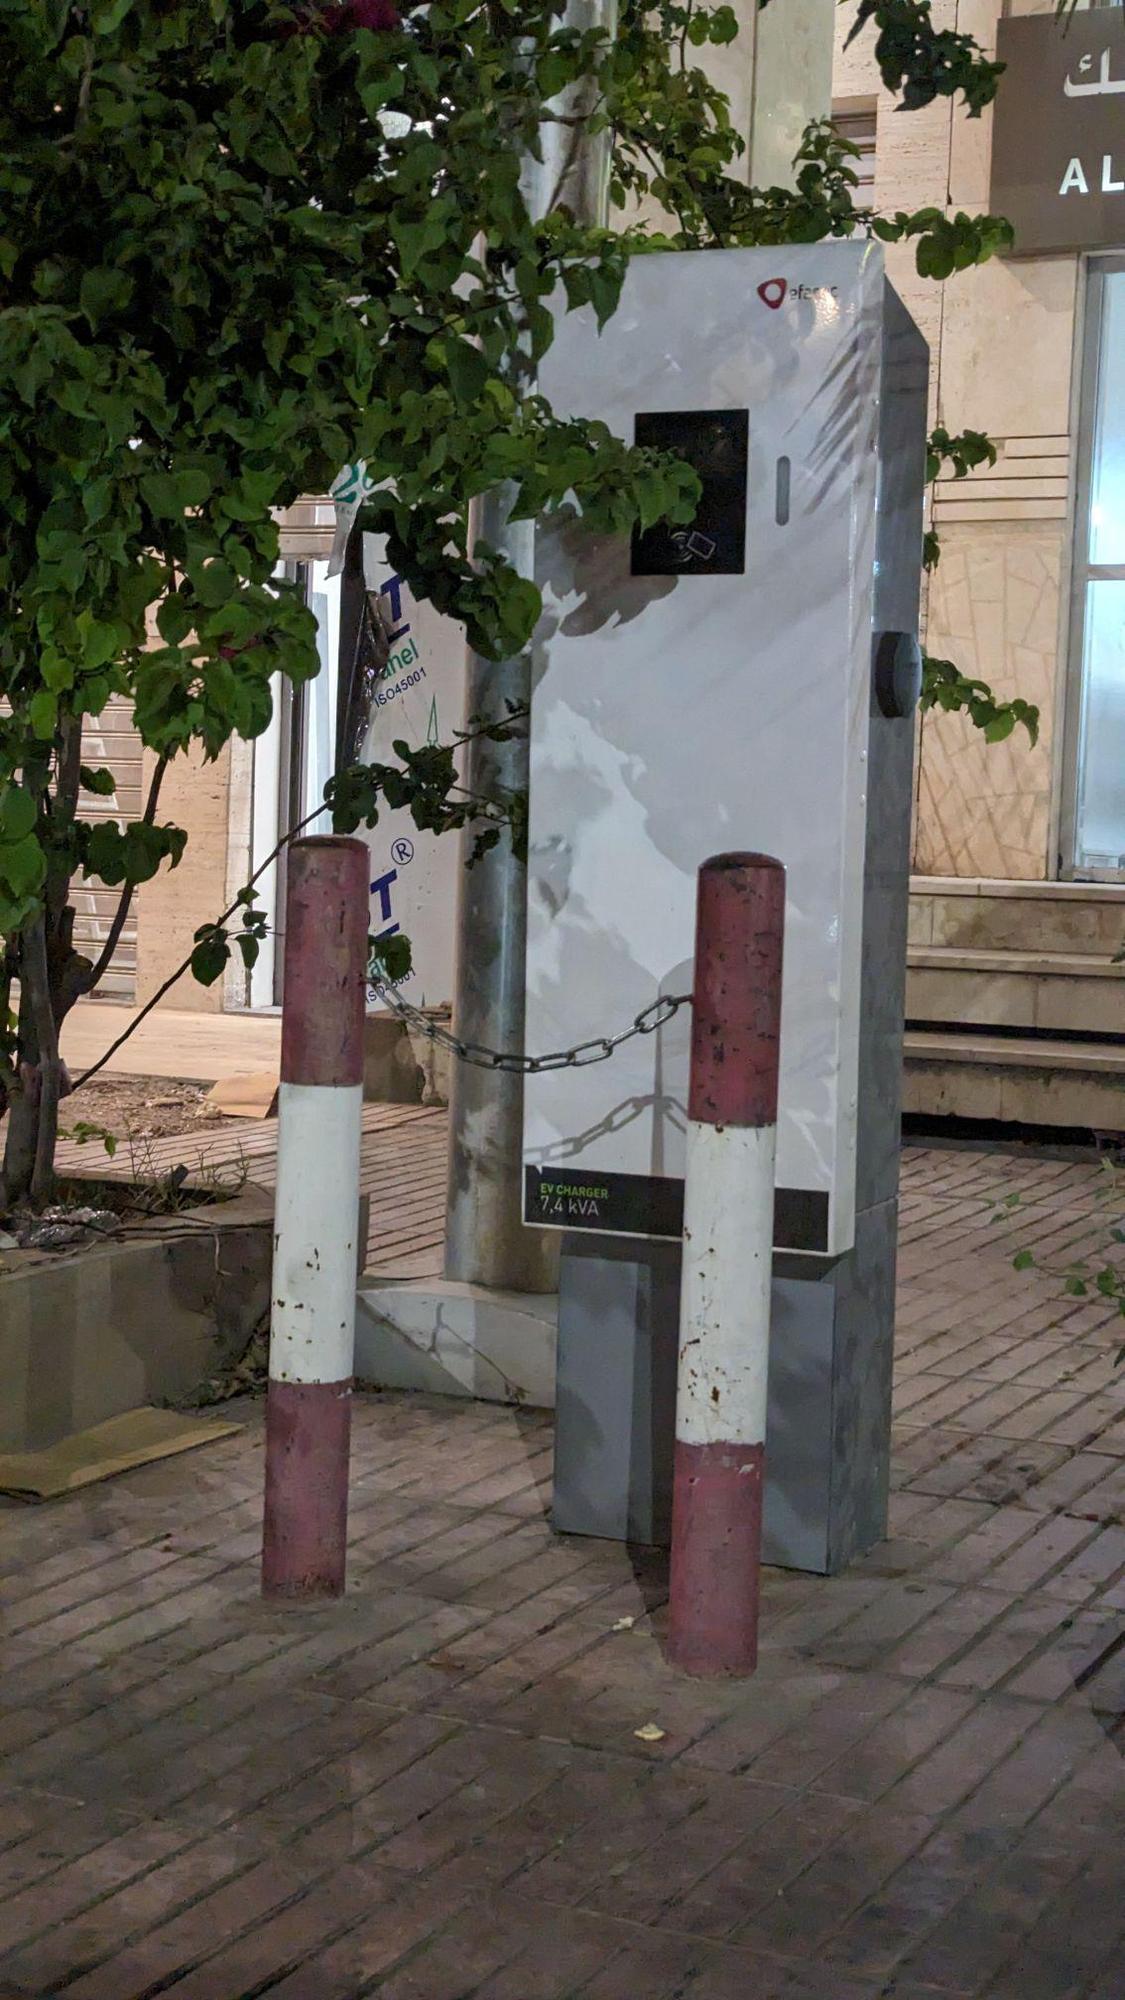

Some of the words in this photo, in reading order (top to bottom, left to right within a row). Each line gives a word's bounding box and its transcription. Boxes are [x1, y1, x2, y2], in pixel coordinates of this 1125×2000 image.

[374, 666, 427, 708] ISO45001
[540, 1183, 554, 1194] EV
[556, 1185, 608, 1199] CHARGER
[540, 1195, 563, 1214] 7,4
[568, 1198, 599, 1216] kVA
